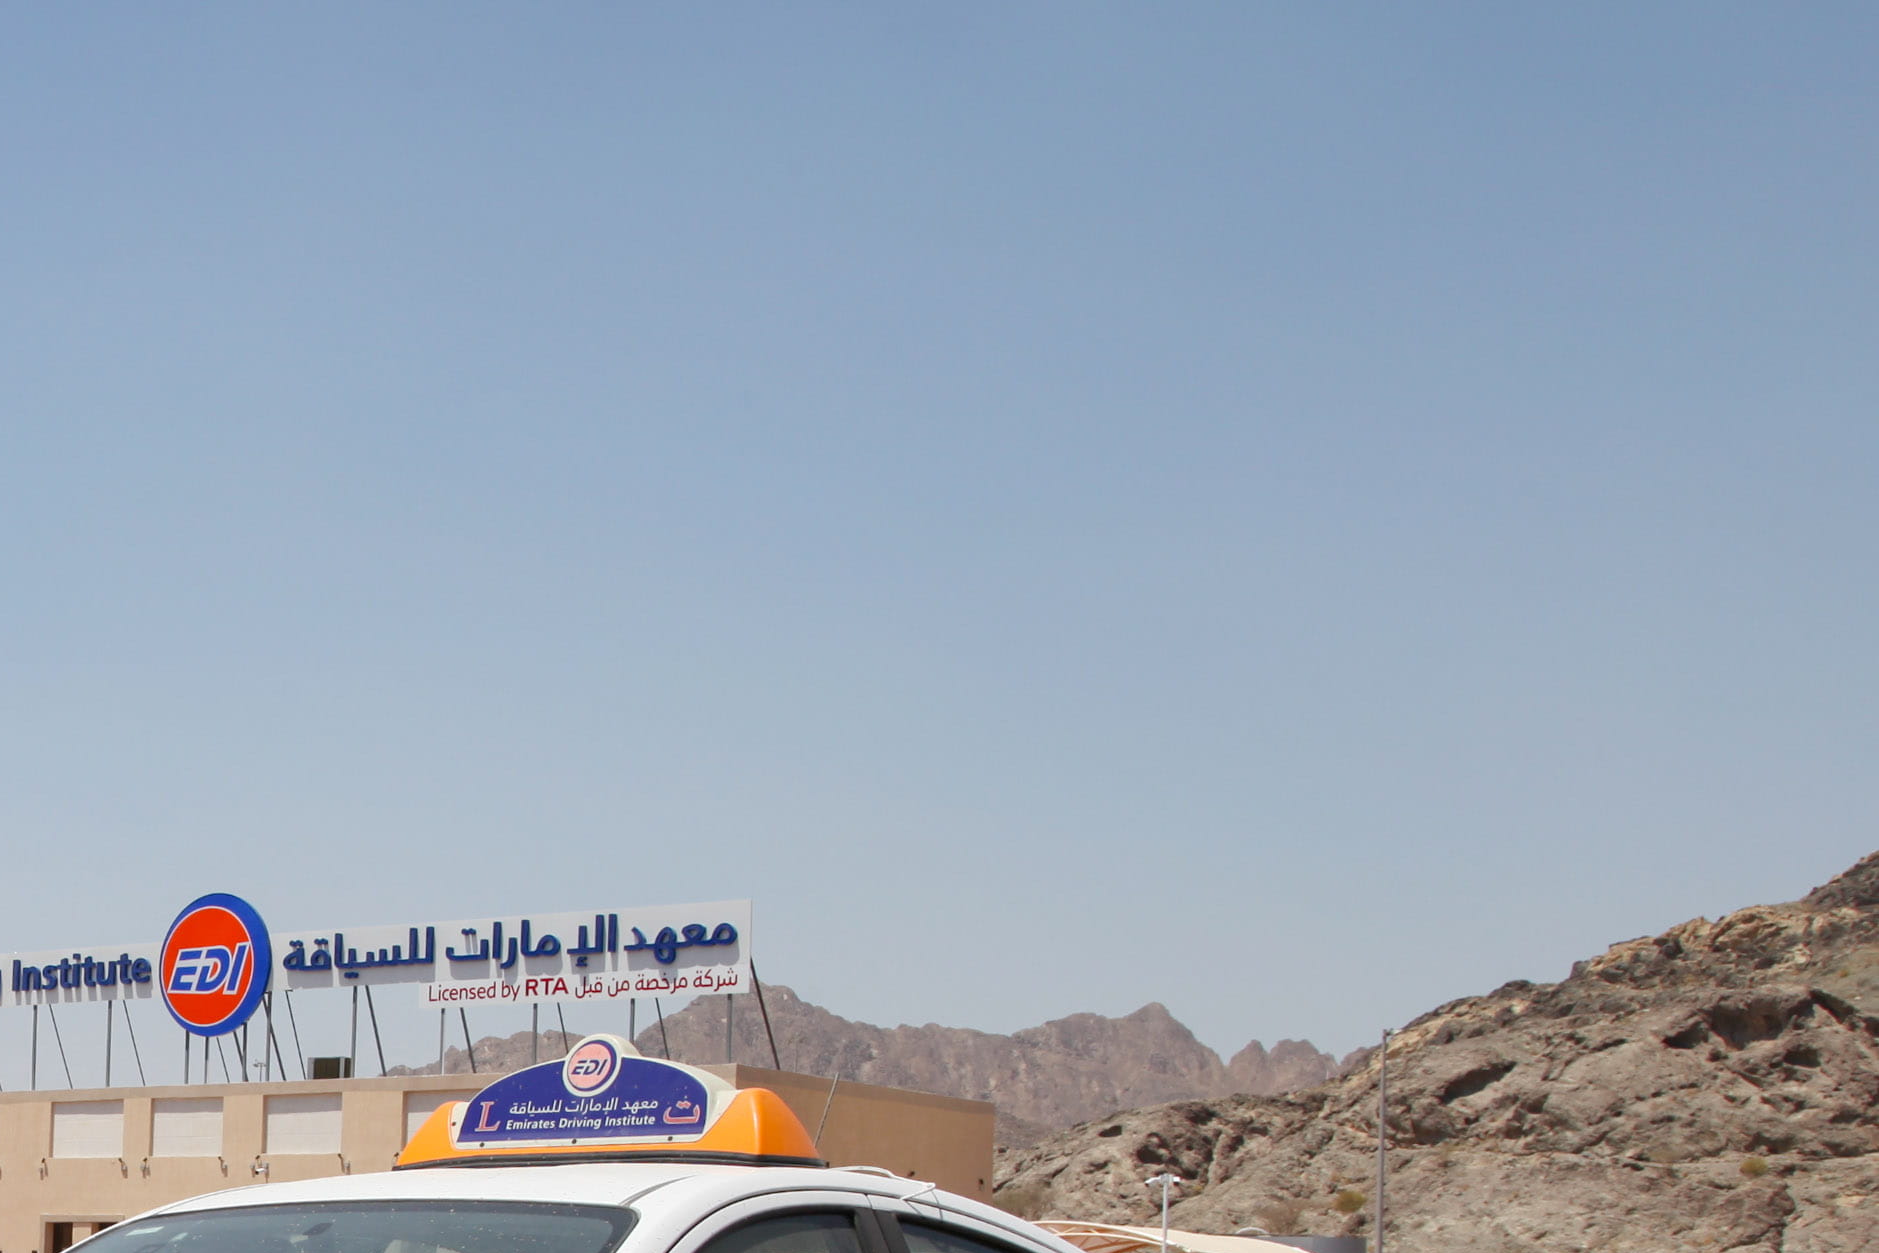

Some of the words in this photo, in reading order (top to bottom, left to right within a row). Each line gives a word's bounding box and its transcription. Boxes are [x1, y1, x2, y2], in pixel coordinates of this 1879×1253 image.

[283, 926, 435, 979] للسياقة
[445, 913, 618, 969] الإمارات
[624, 922, 738, 964] معهد
[12, 953, 152, 992] Institute
[167, 941, 250, 995] EDI
[693, 967, 738, 992] شركة
[428, 984, 496, 1002] Licensed
[501, 983, 520, 1001] by
[525, 978, 569, 997] RTA
[575, 975, 603, 998] قبل
[610, 977, 631, 997] من
[635, 973, 688, 994] مرخصة
[571, 1059, 608, 1076] EDI
[475, 1101, 500, 1132] L
[509, 1099, 562, 1117] للسياقة
[622, 1099, 658, 1114] معهد
[506, 1118, 555, 1131] Emirates
[559, 1117, 601, 1130] Driving
[605, 1115, 656, 1128] Institute
